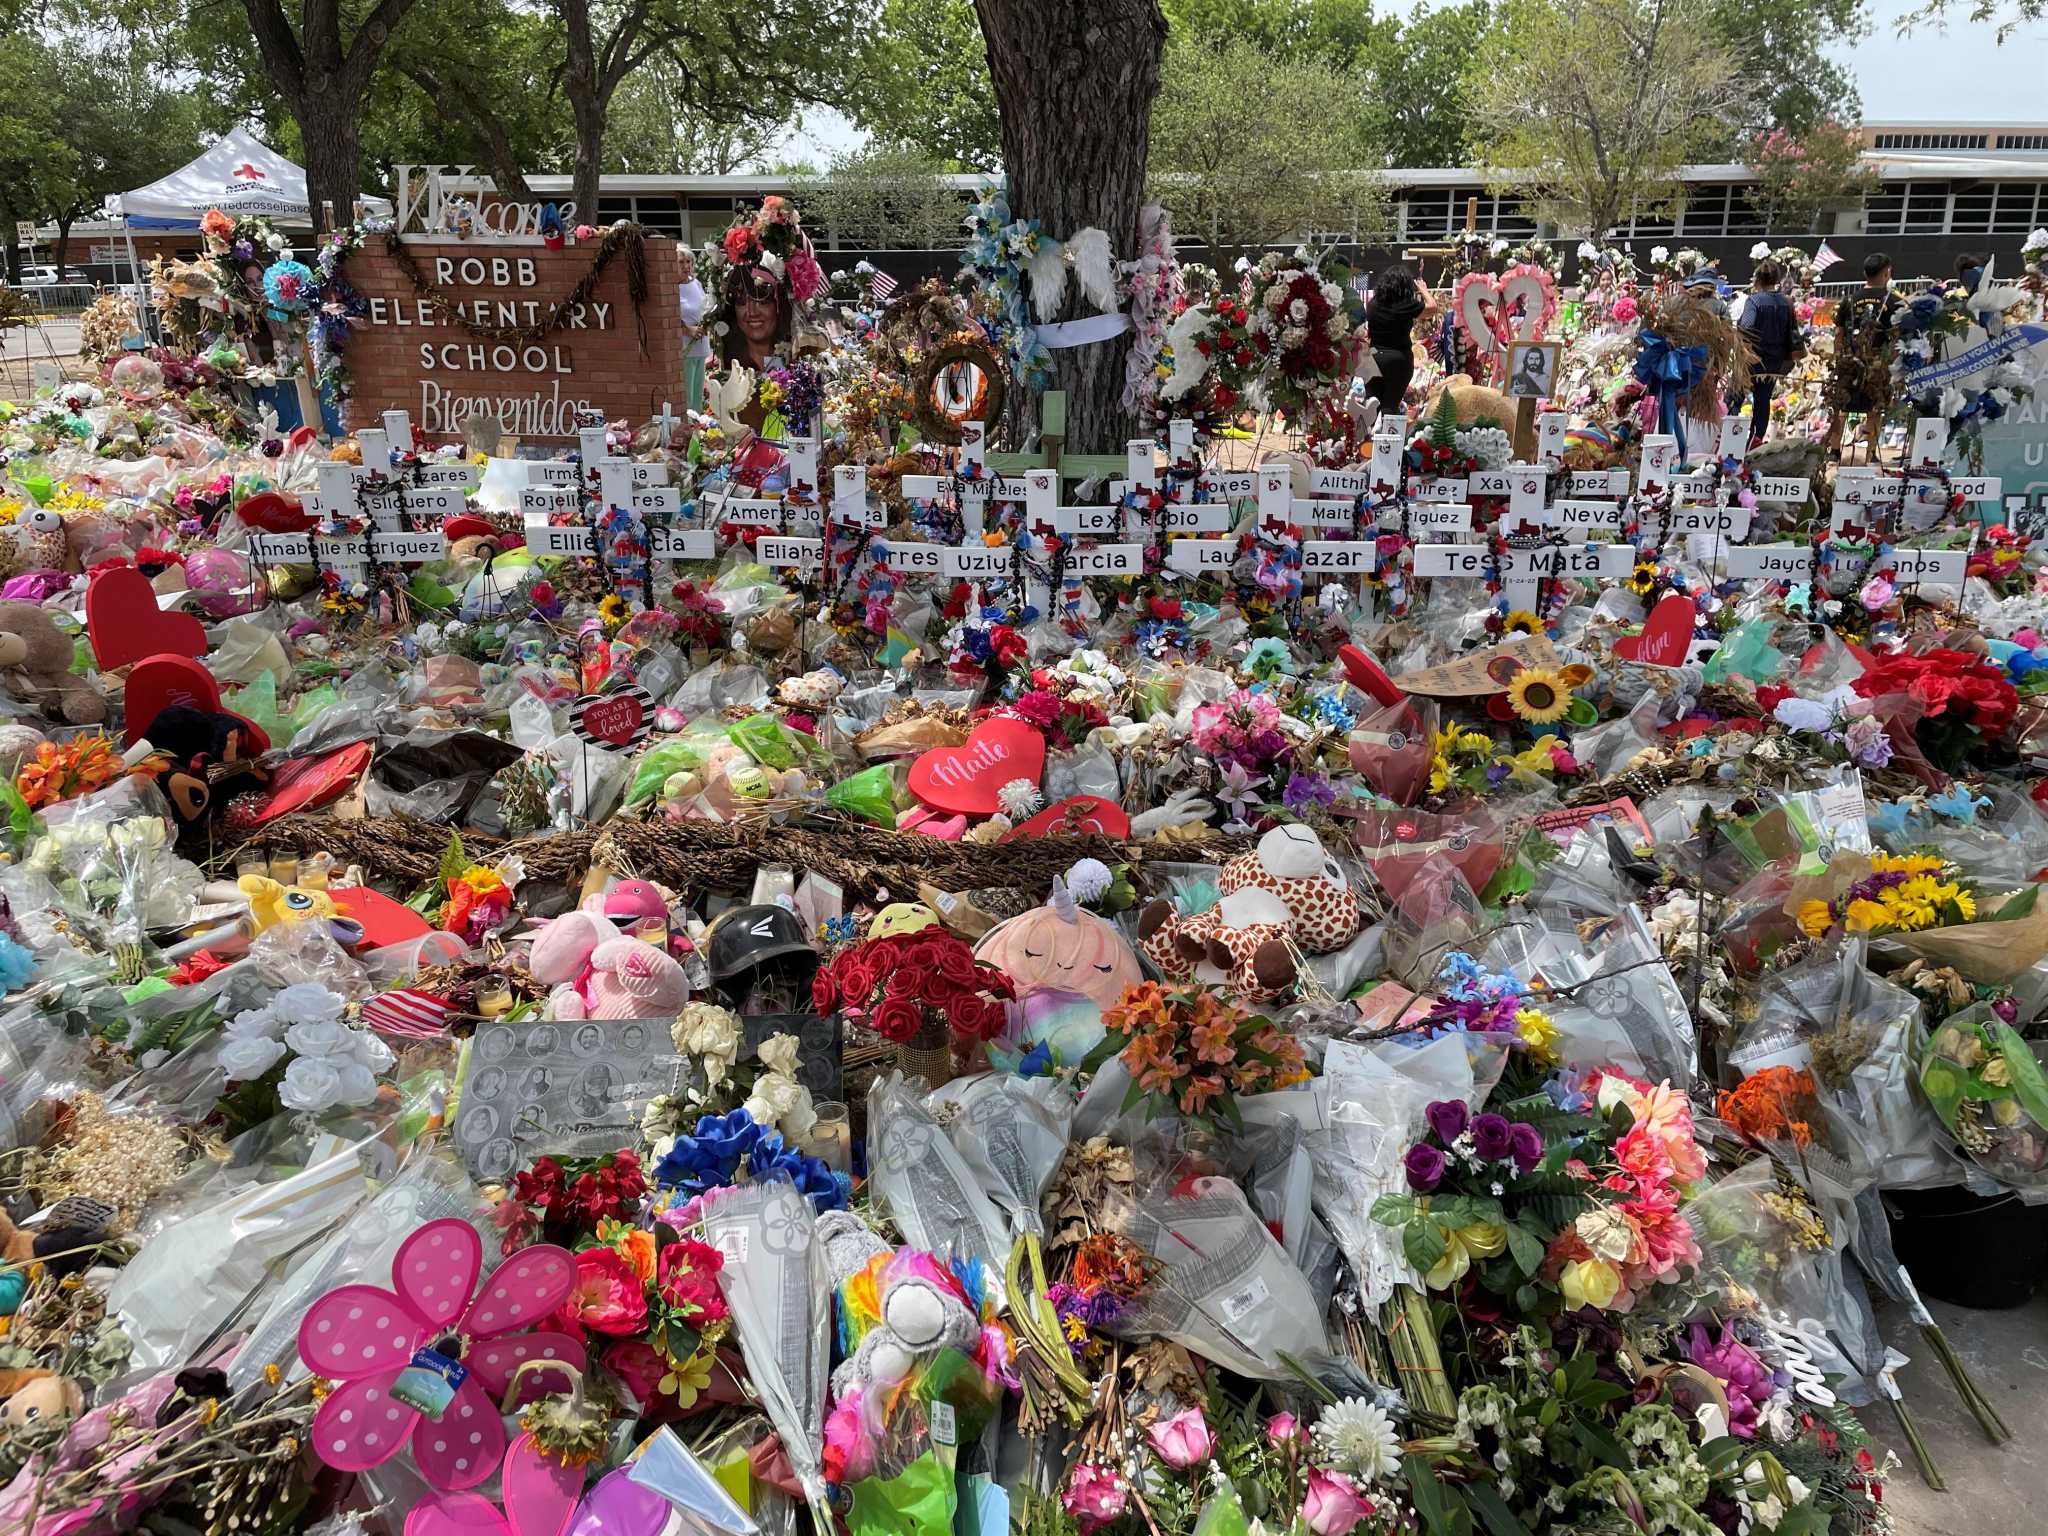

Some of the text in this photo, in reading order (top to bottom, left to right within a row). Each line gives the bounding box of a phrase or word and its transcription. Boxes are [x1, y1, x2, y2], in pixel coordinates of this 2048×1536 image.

[19, 222, 33, 230] ONE
[436, 257, 537, 286] ROBB
[369, 298, 612, 330] ELEENTRY
[420, 343, 572, 374] SCHOOL
[1969, 345, 1989, 359] YOU
[419, 379, 591, 435] Bienvenidos
[544, 468, 583, 480] Irma
[937, 481, 966, 493] Eva
[1208, 479, 1251, 494] ores
[1319, 475, 1368, 491] Alithi
[1414, 480, 1458, 496] irez
[1481, 477, 1608, 492] Xav opez
[1754, 483, 1800, 496] athis
[1951, 483, 1986, 495] rod
[632, 495, 665, 507] res
[730, 506, 820, 521] Amere Jo
[1311, 507, 1350, 520] Mait
[1562, 508, 1619, 523] Neva
[346, 541, 440, 557] Rodriguez
[549, 533, 595, 551] Ellie
[886, 551, 939, 566] rres
[957, 553, 1127, 573] Uziya arcia
[1200, 549, 1363, 567] Lay azar
[1444, 553, 1600, 572] Tess Mata
[1759, 556, 1818, 573] Jayce
[591, 701, 630, 720] YOU ARE
[608, 713, 621, 723] SO
[598, 708, 635, 736] loved
[928, 738, 1010, 786] Maite
